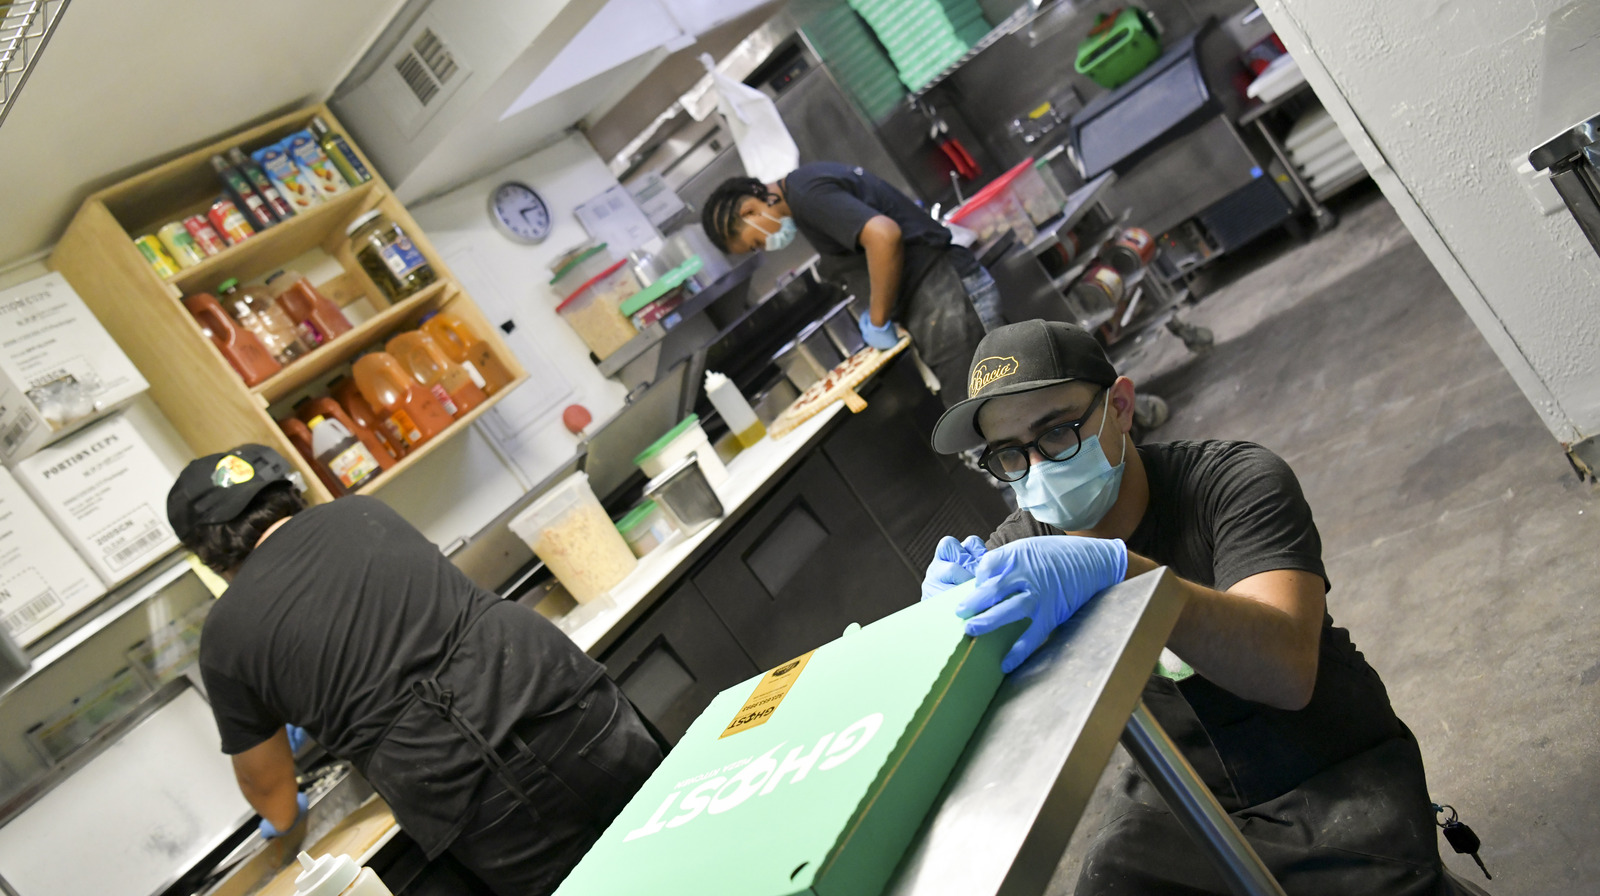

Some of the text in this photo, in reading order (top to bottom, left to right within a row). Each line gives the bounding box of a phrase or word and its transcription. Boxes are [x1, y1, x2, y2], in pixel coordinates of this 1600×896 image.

[970, 363, 1012, 393] Bacio
[42, 447, 91, 480] PORTION
[90, 433, 120, 454] CUPS
[727, 706, 775, 730] GHOST
[622, 711, 885, 843] GHOST
